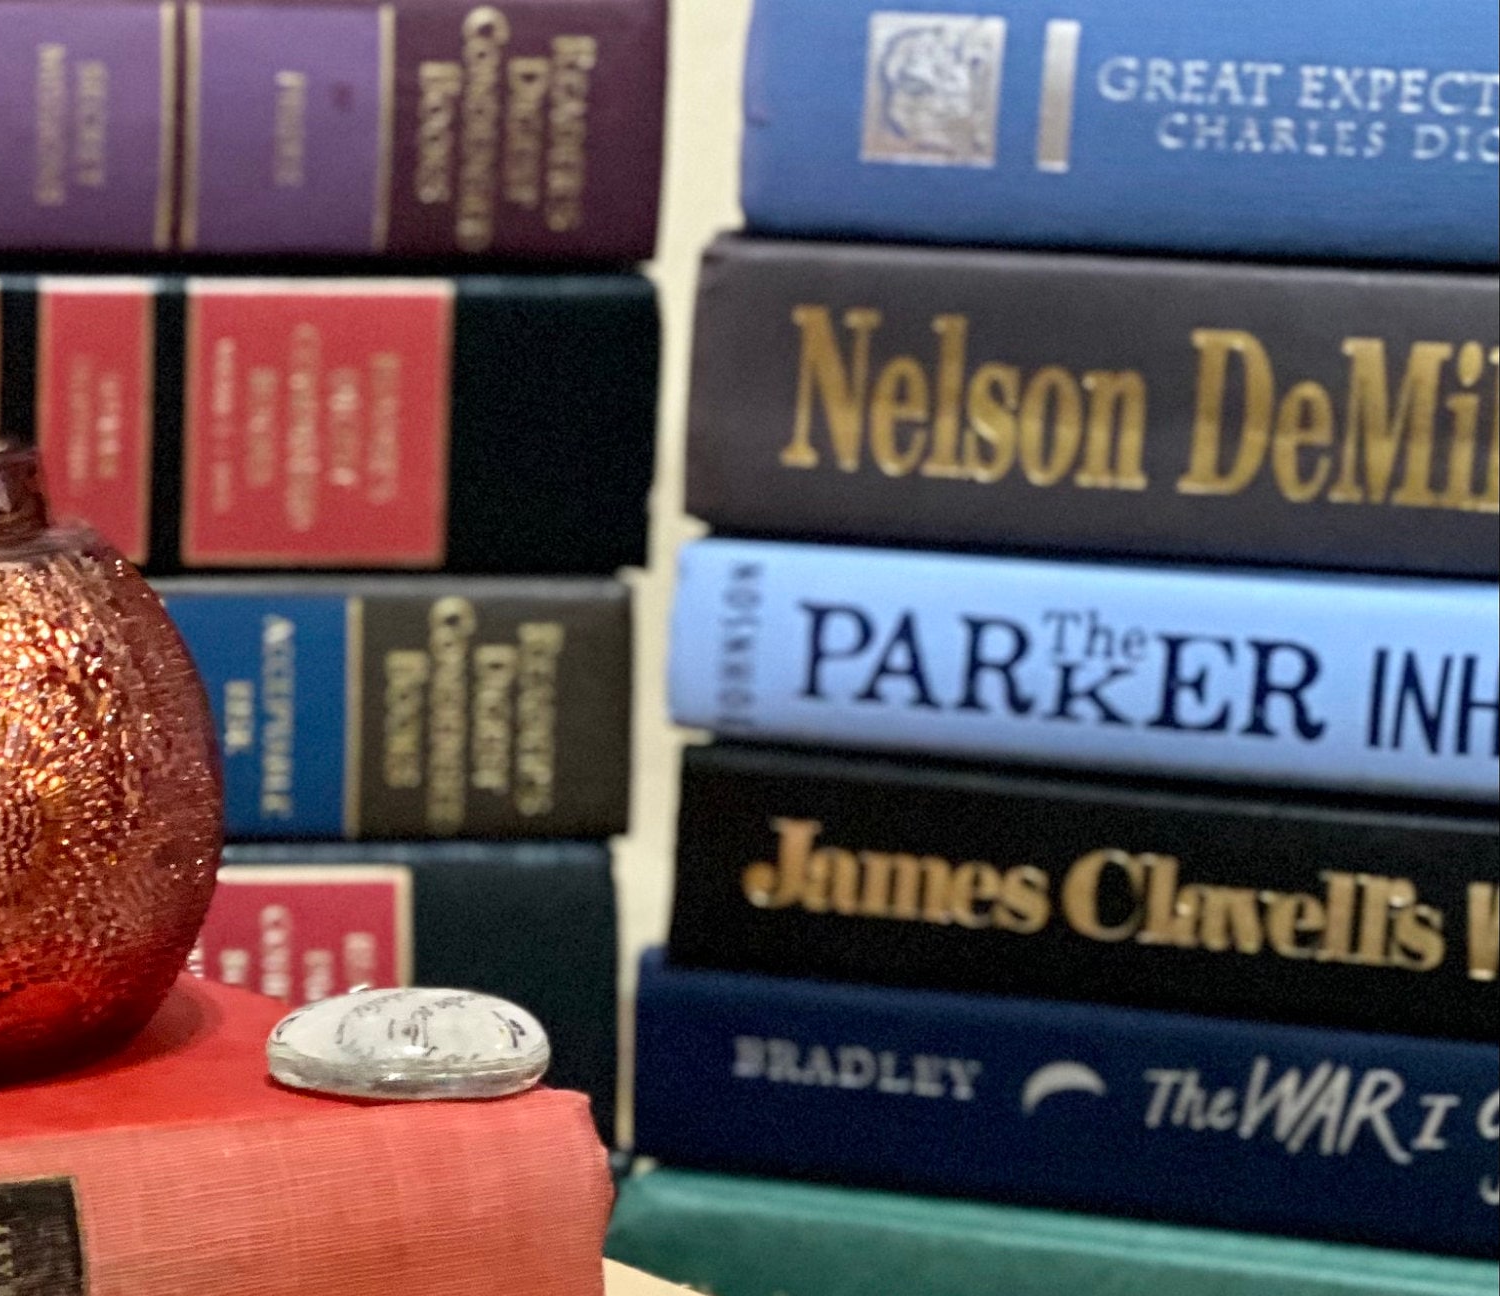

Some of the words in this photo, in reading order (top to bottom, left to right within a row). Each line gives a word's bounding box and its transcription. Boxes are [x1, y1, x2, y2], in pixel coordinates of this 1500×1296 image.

[1098, 56, 1282, 106] GREAT
[1296, 64, 1499, 117] EXPECT
[1157, 114, 1388, 160] CHARLES
[781, 304, 1151, 492] Nelson
[797, 602, 1327, 742] PARKER
[1043, 611, 1148, 666] The
[742, 816, 1052, 934] James
[1061, 849, 1445, 973] Clavell's
[732, 1034, 983, 1101] BRADLEY
[1142, 1069, 1237, 1131] The
[1238, 1055, 1412, 1165] WAR
[1411, 1094, 1461, 1150] I
